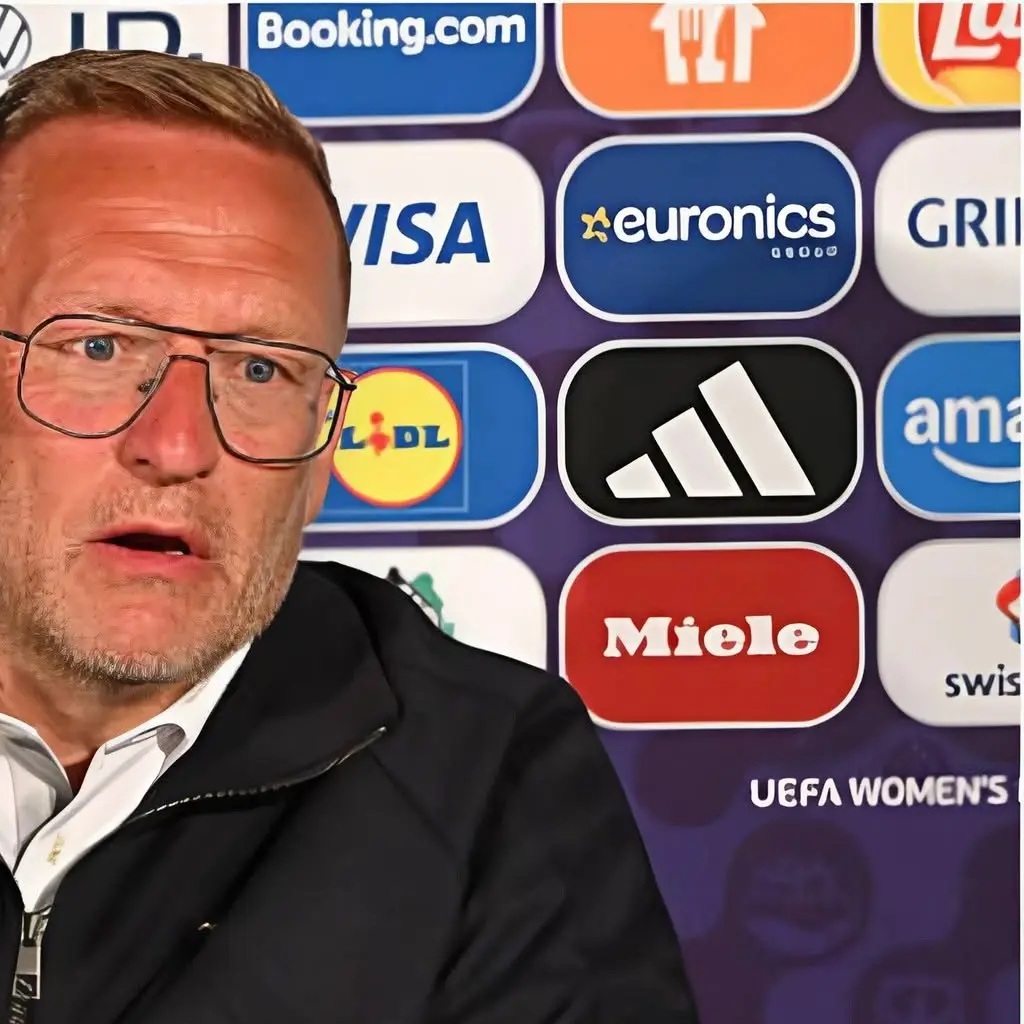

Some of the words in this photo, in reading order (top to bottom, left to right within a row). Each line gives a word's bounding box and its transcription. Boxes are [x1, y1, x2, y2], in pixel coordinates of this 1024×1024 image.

[257, 9, 526, 55] Booking.com
[613, 193, 836, 243] euronics
[603, 615, 820, 659] Miele
[750, 777, 843, 808] UEFA
[848, 774, 1009, 807] WOMEN'S
